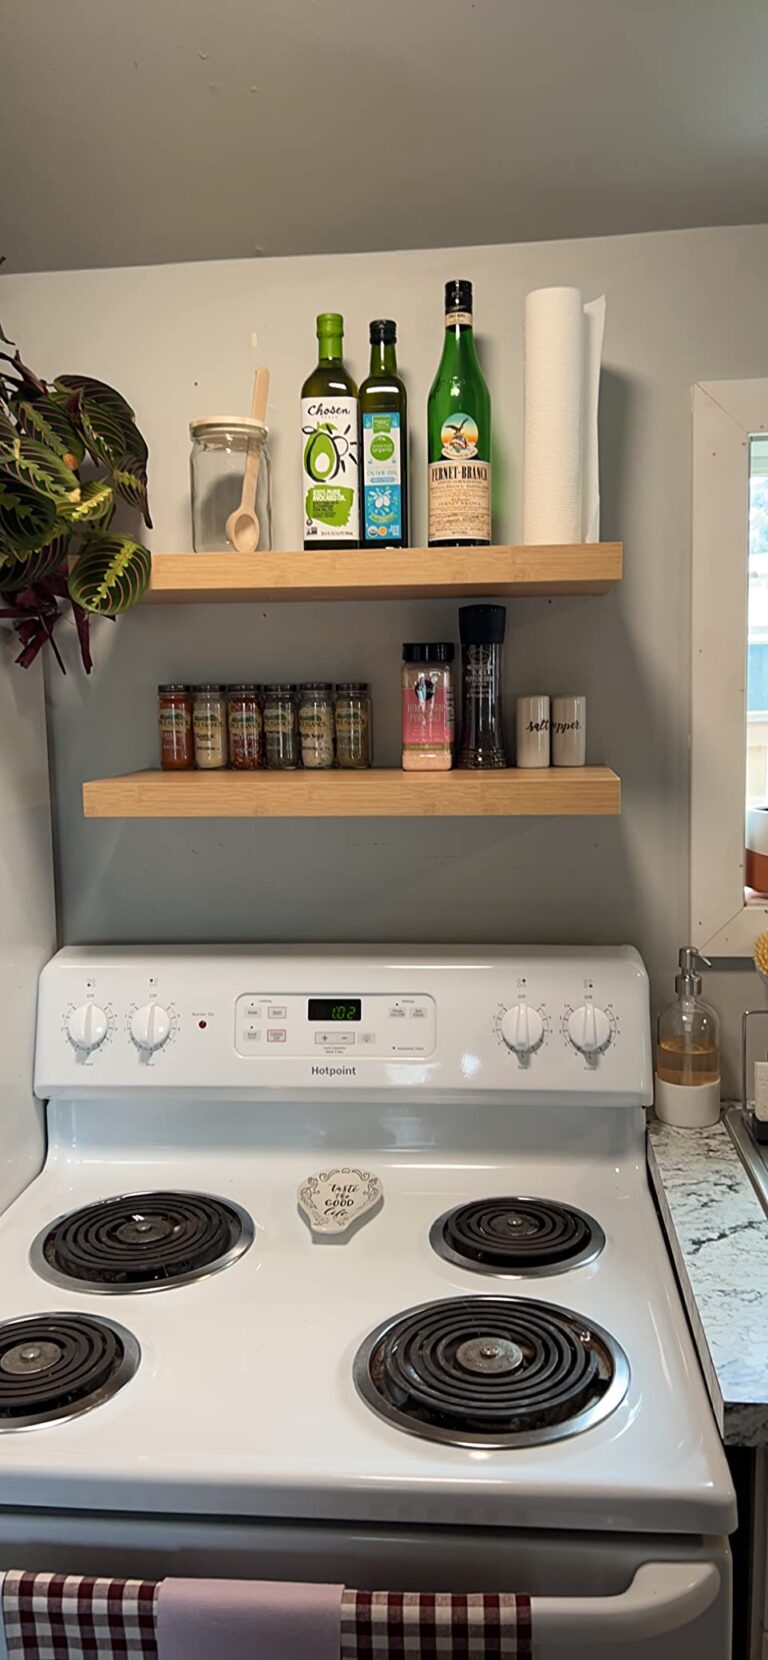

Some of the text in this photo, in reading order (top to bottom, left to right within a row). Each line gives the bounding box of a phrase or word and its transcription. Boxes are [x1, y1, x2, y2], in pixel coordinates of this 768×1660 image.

[307, 402, 350, 416] Chosen
[525, 719, 549, 732] salt
[311, 1066, 357, 1078] Hotpoint
[330, 1184, 358, 1193] taste
[324, 1199, 354, 1207] GOOD
